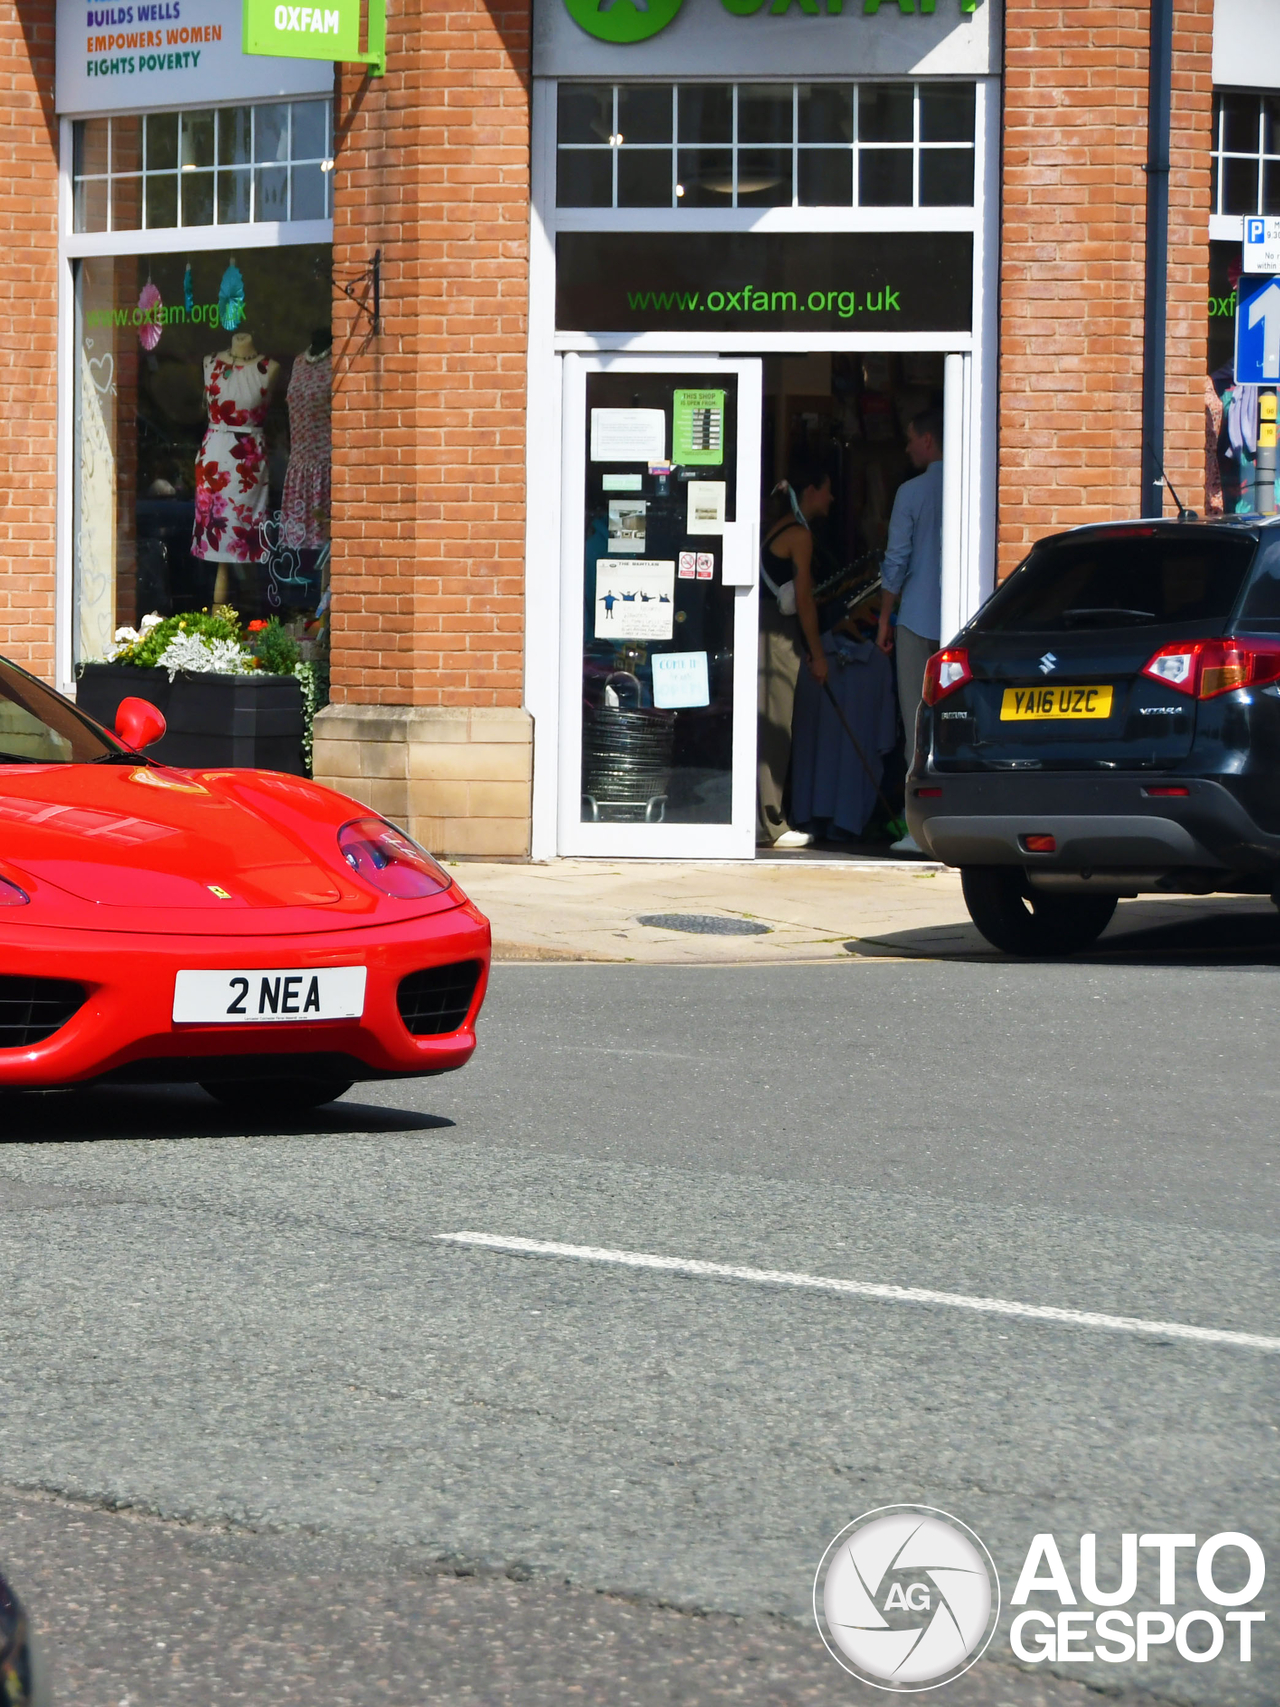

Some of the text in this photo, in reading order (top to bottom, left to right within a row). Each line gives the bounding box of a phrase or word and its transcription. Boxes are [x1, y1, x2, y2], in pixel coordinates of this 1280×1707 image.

[87, 1, 180, 27] BUILDS WELLS
[274, 6, 339, 34] OXFAM
[87, 25, 222, 53] EMPOWERS WOMEN
[87, 50, 201, 77] FIGHTS POVERTY
[1257, 262, 1277, 270] within
[1265, 252, 1274, 260] No
[85, 300, 247, 329] www.oxfam.org.uk
[627, 285, 901, 318] www.oxfam.org.uk
[1014, 689, 1099, 715] YA16 UZC
[1139, 706, 1182, 716] VITARA
[226, 976, 320, 1014] 2 NEA
